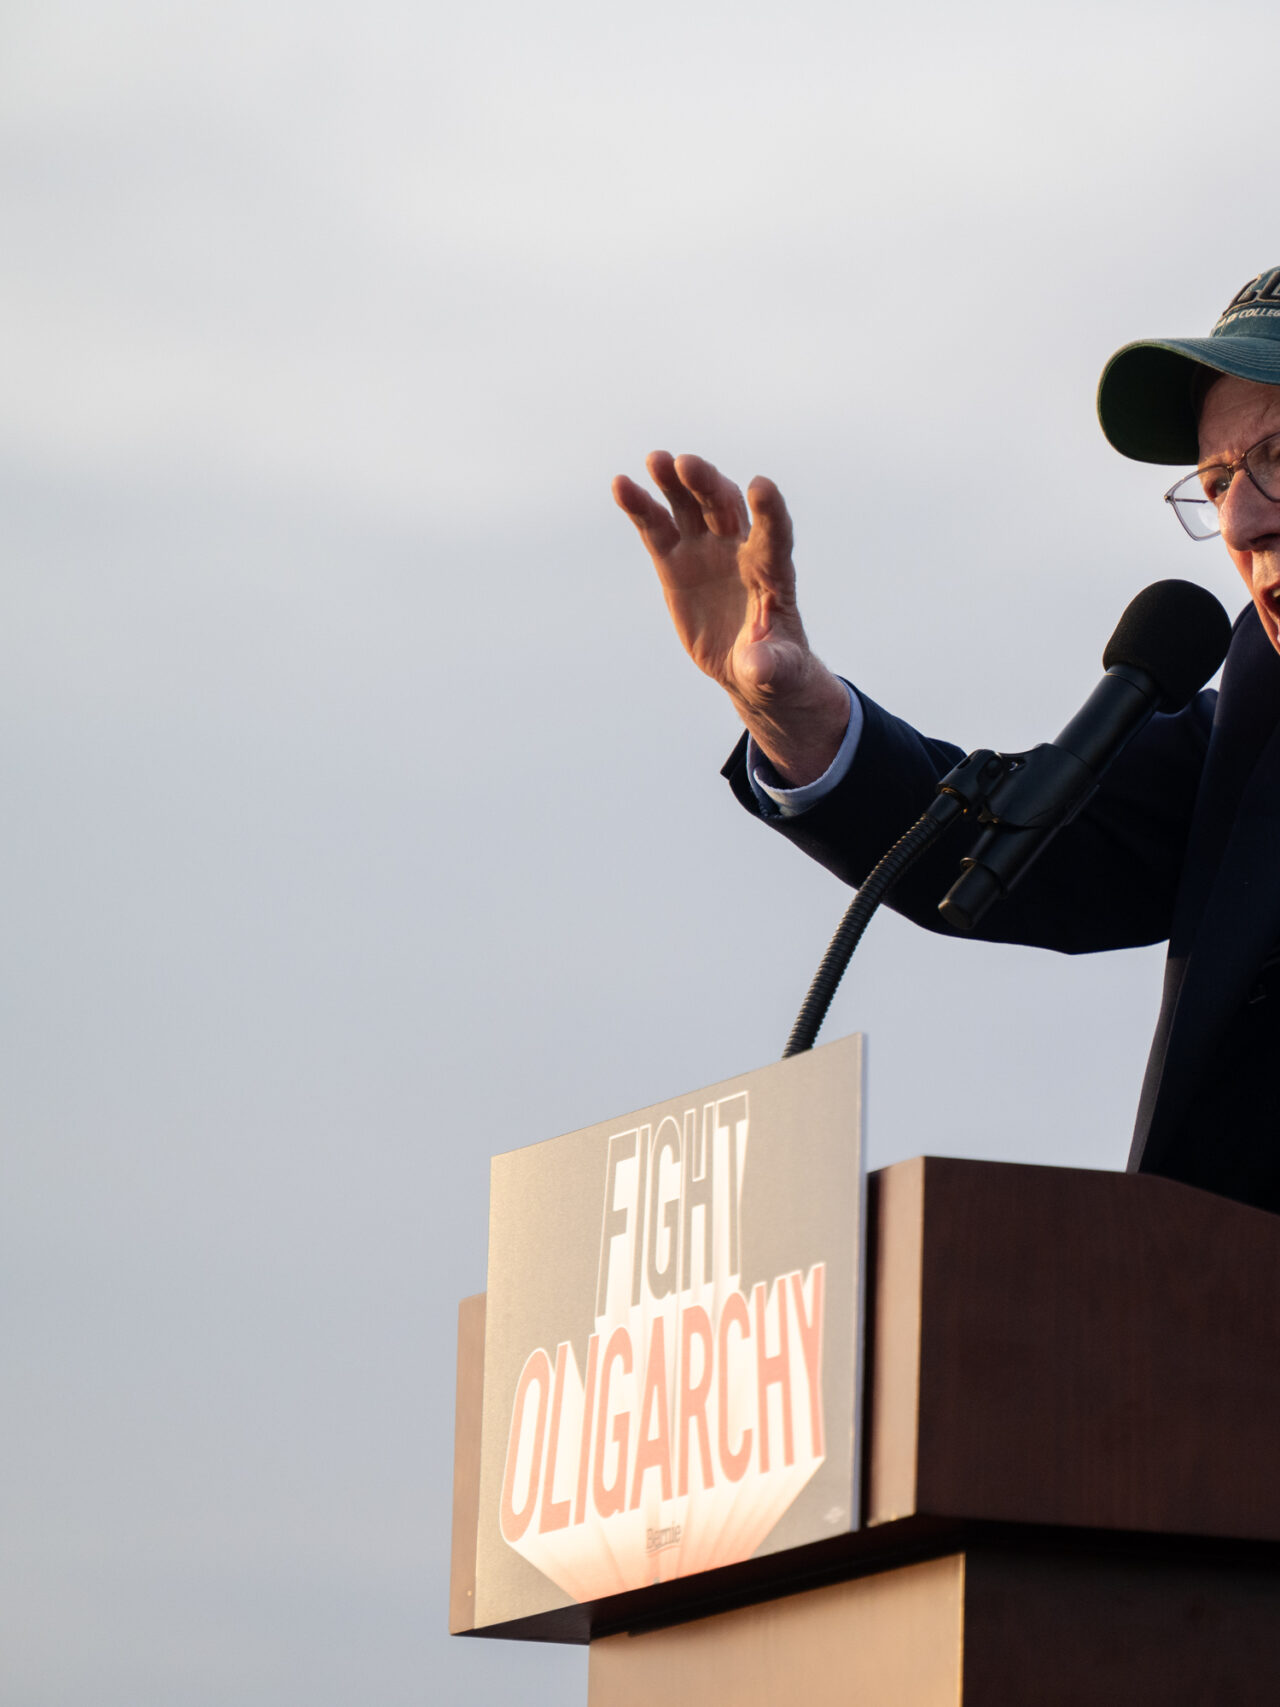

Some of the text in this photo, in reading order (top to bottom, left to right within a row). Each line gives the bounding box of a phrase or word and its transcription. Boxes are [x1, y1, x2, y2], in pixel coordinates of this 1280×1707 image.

[595, 1091, 750, 1322] FIGHT
[499, 1262, 827, 1544] OLIGARCHY
[646, 1522, 681, 1549] Bernie
